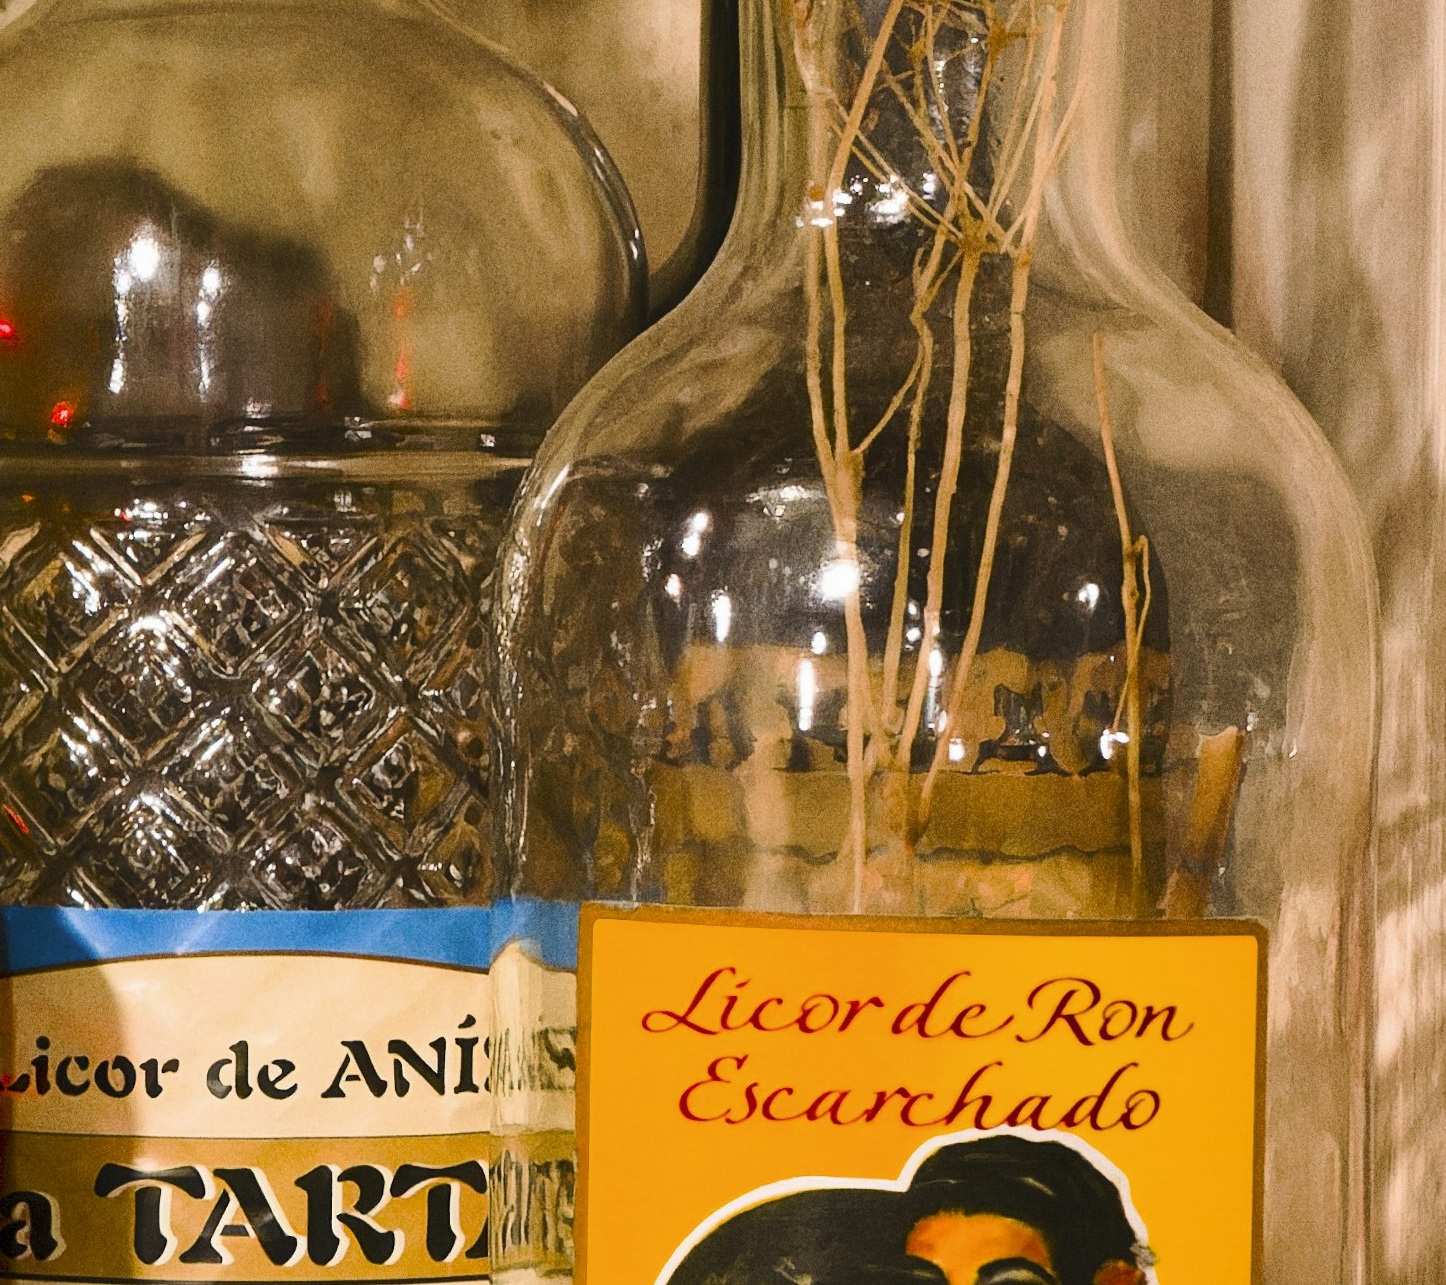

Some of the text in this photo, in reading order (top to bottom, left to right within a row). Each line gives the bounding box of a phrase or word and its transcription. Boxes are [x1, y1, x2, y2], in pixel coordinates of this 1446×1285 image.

[640, 965, 1197, 1049] Licor de Ron
[205, 1038, 300, 1101] de
[677, 1052, 1162, 1134] Escarchado
